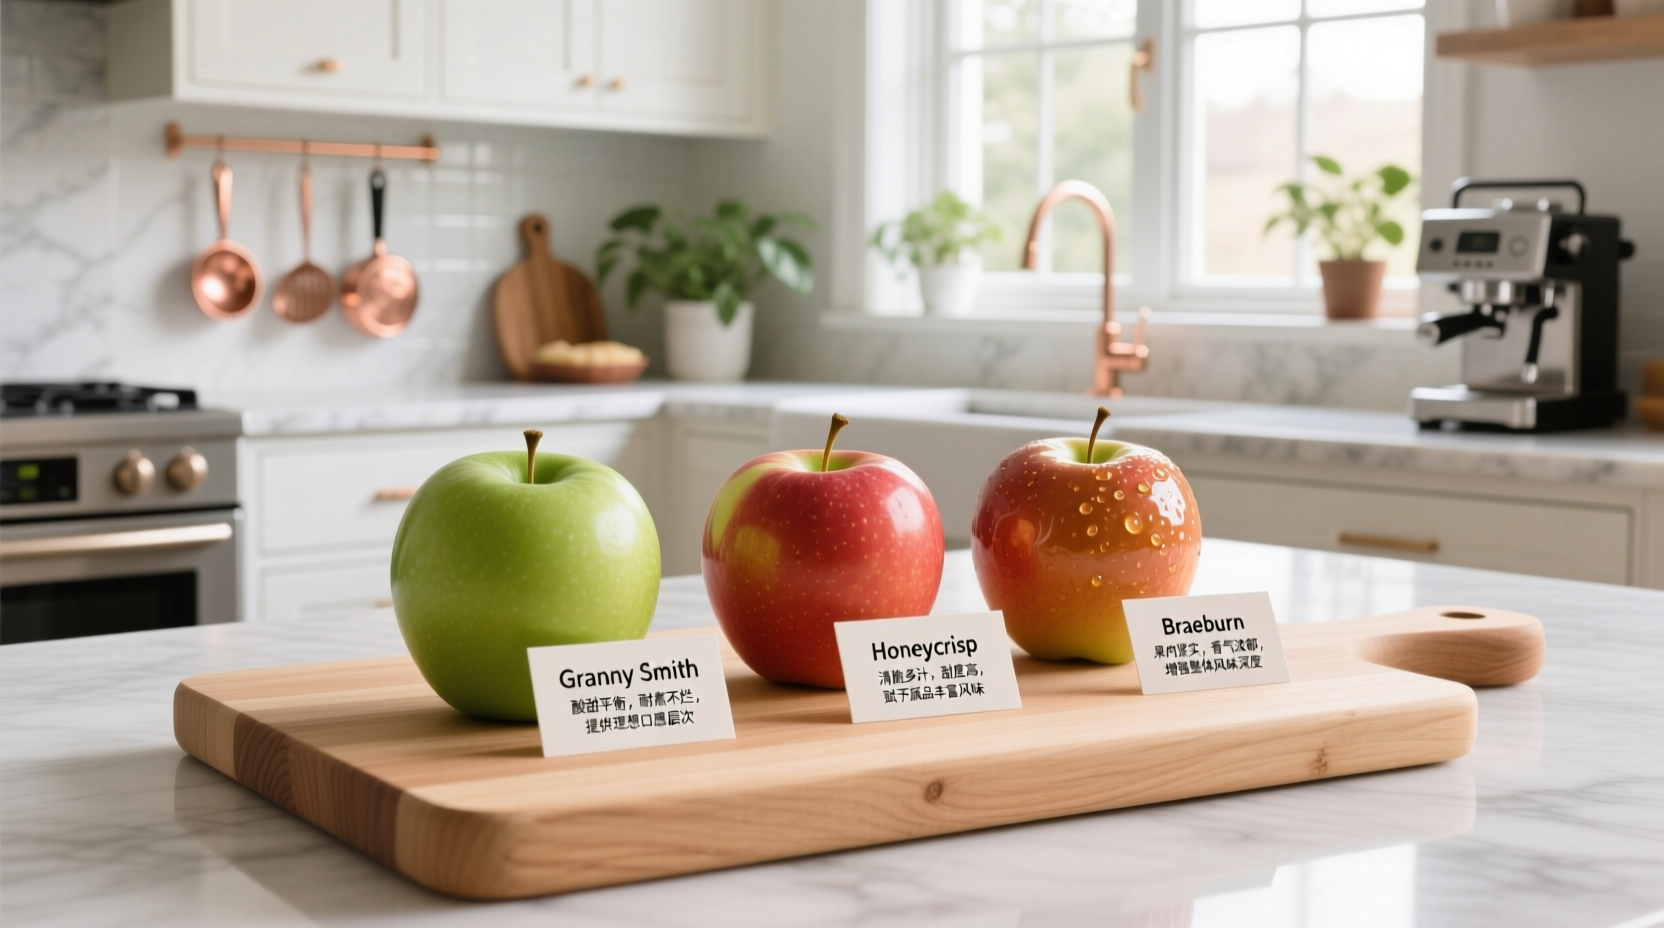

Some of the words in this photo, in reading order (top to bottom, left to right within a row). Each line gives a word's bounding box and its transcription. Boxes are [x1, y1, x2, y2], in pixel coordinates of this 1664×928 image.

[1161, 614, 1245, 635] Braeburn
[871, 635, 978, 662] Honeycrisp
[559, 668, 634, 689] Granny
[639, 658, 699, 682] Smith
